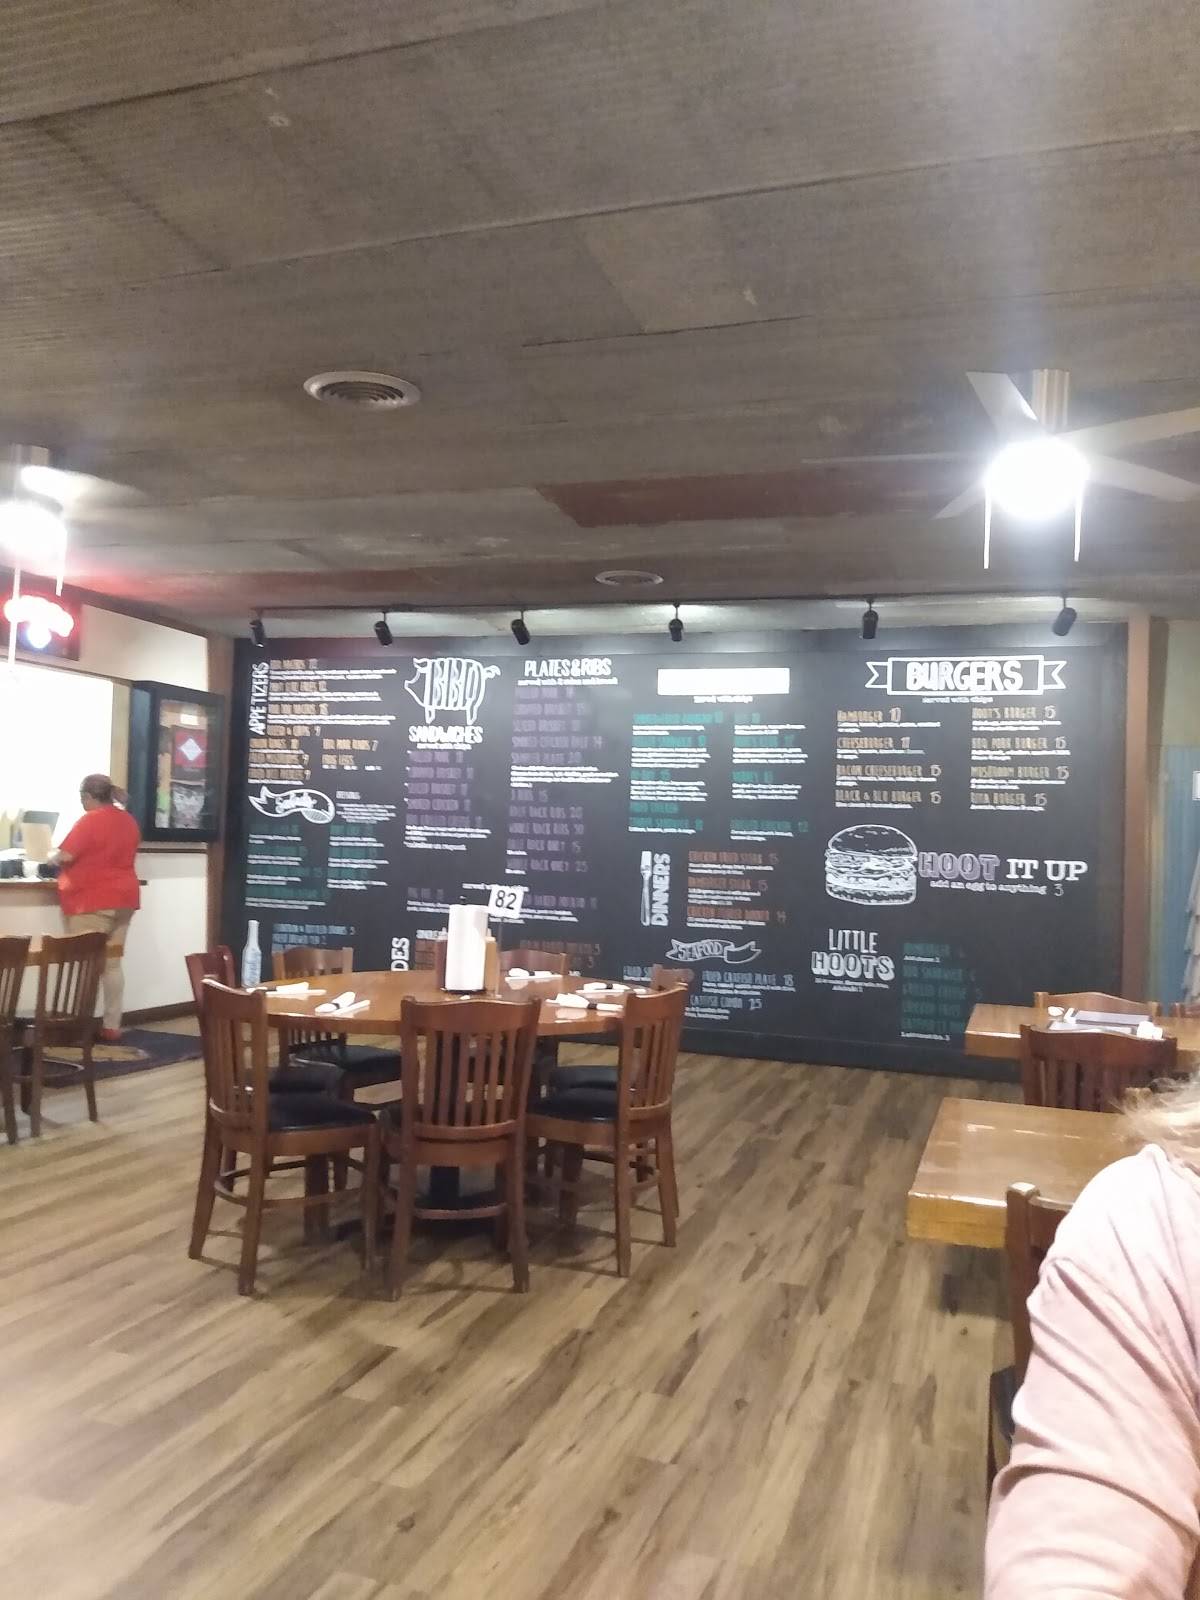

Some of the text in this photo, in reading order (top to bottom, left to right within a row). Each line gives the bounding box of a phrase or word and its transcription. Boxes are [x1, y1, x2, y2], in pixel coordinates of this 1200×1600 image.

[906, 660, 1024, 692] BURGERS
[249, 662, 269, 736] APPETIZERS
[408, 725, 483, 744] SANDWICHES
[918, 851, 1088, 881] HOOT IT UP
[495, 890, 517, 911] 82
[650, 852, 671, 927] DINNERS
[391, 937, 410, 972] DES
[677, 940, 723, 961] SEAFOOD
[828, 928, 878, 953] LITTLE
[811, 951, 896, 981] HOOTS
